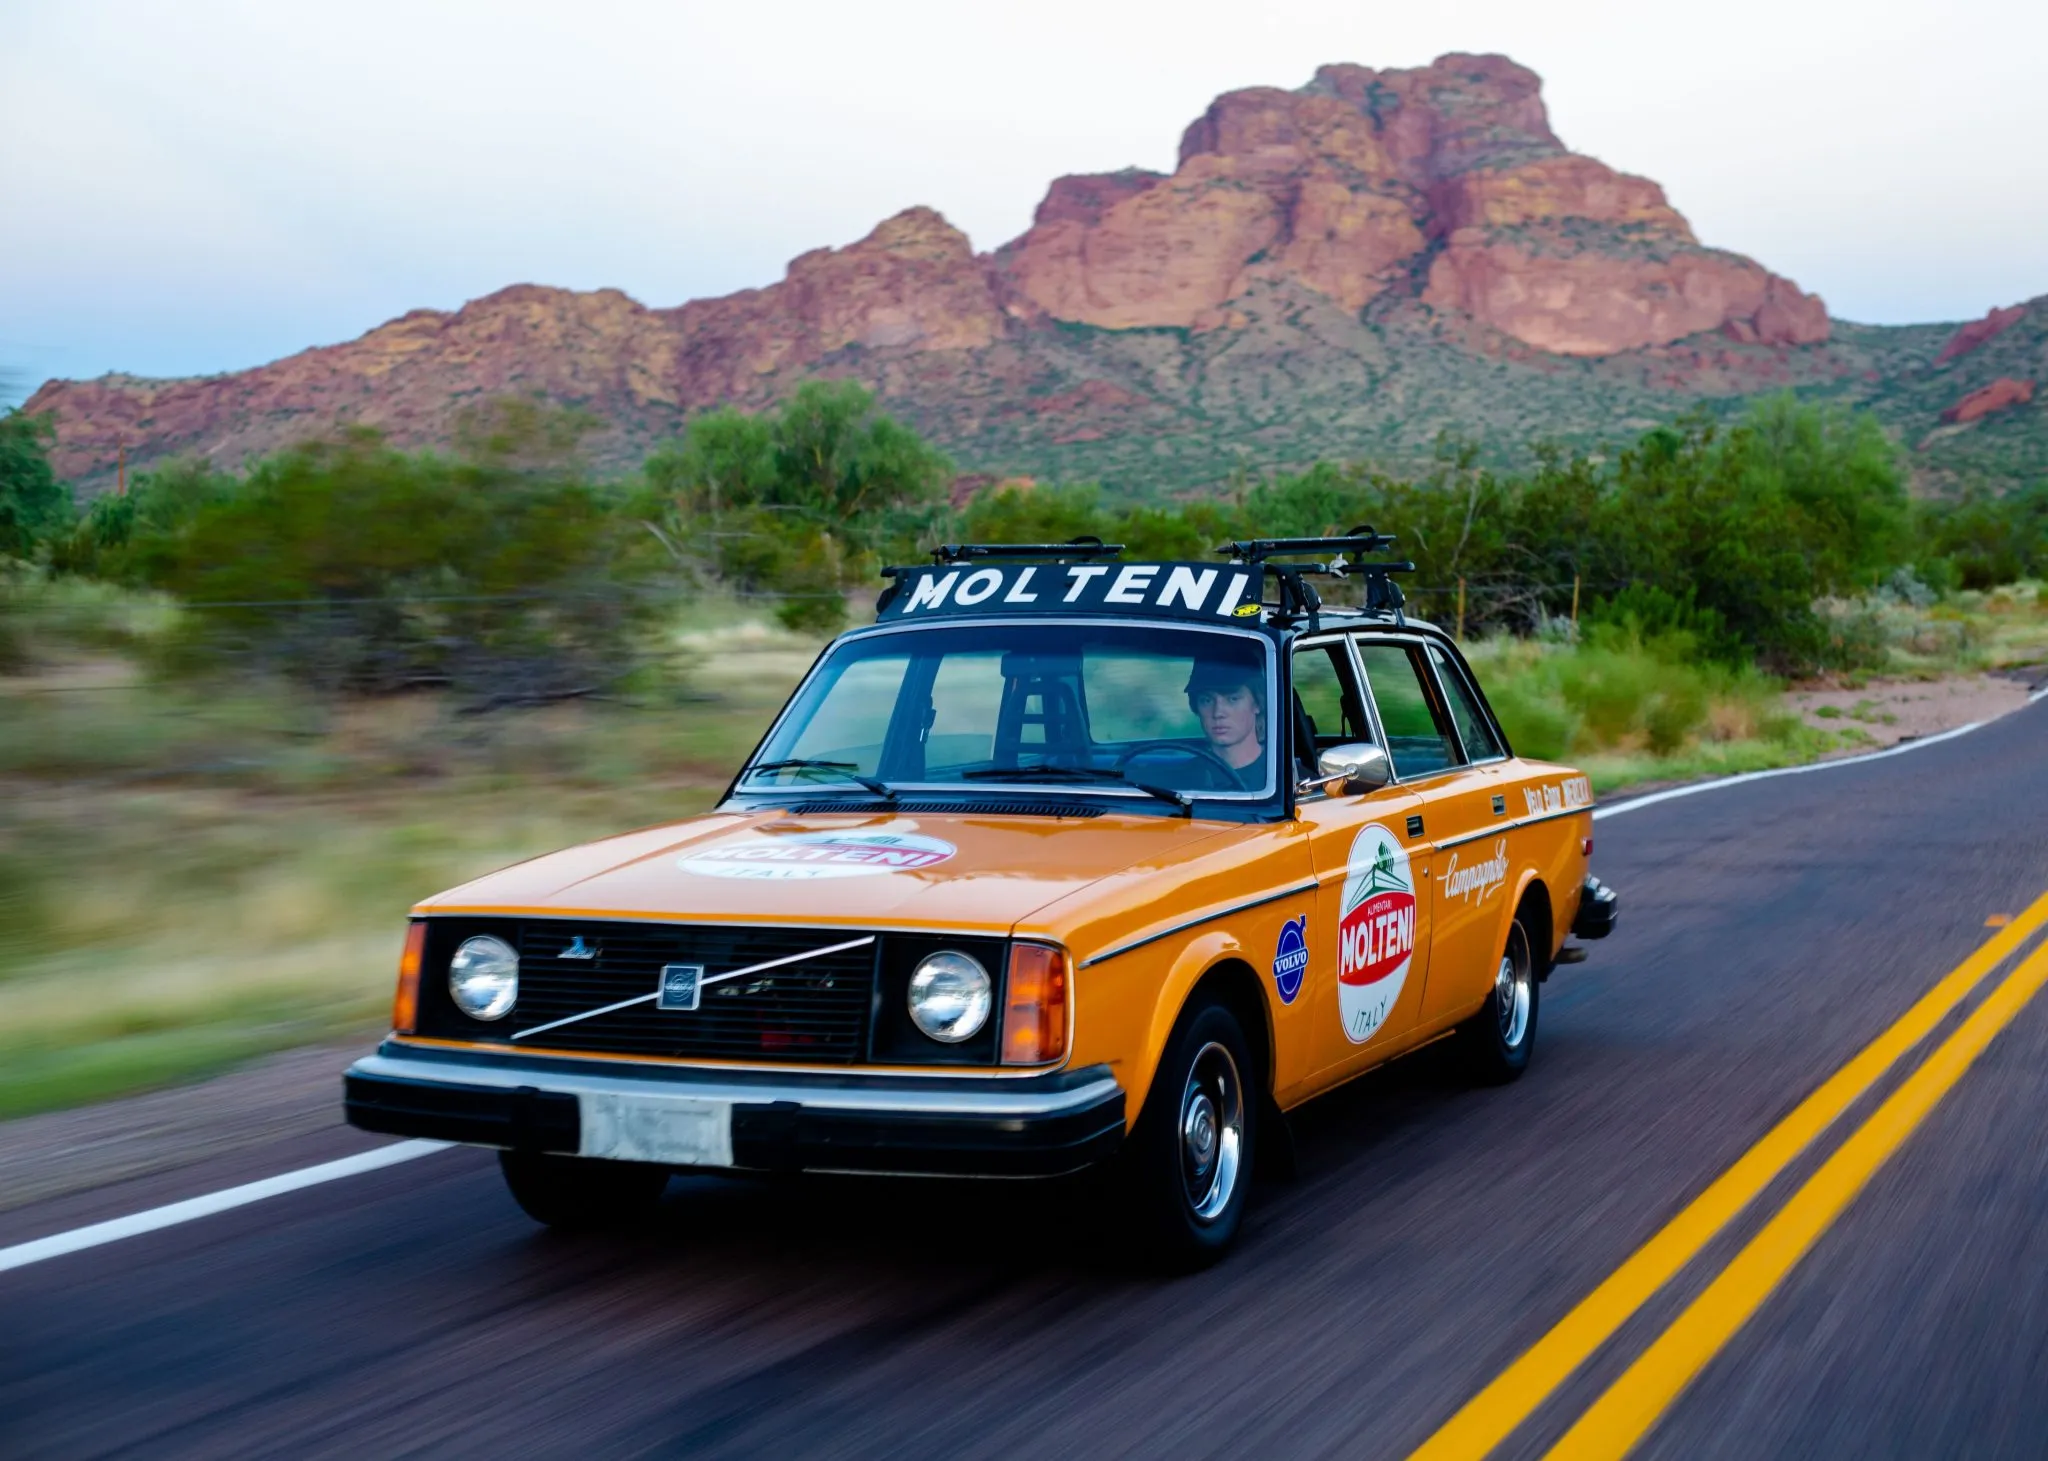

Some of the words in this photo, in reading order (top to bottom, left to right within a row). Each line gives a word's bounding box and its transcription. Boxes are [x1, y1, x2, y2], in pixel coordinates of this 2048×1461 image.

[698, 847, 939, 867] MOLTENI
[1340, 905, 1414, 977] MOLTENI
[1275, 951, 1307, 973] VOLVO
[1353, 994, 1387, 1034] ITALY
